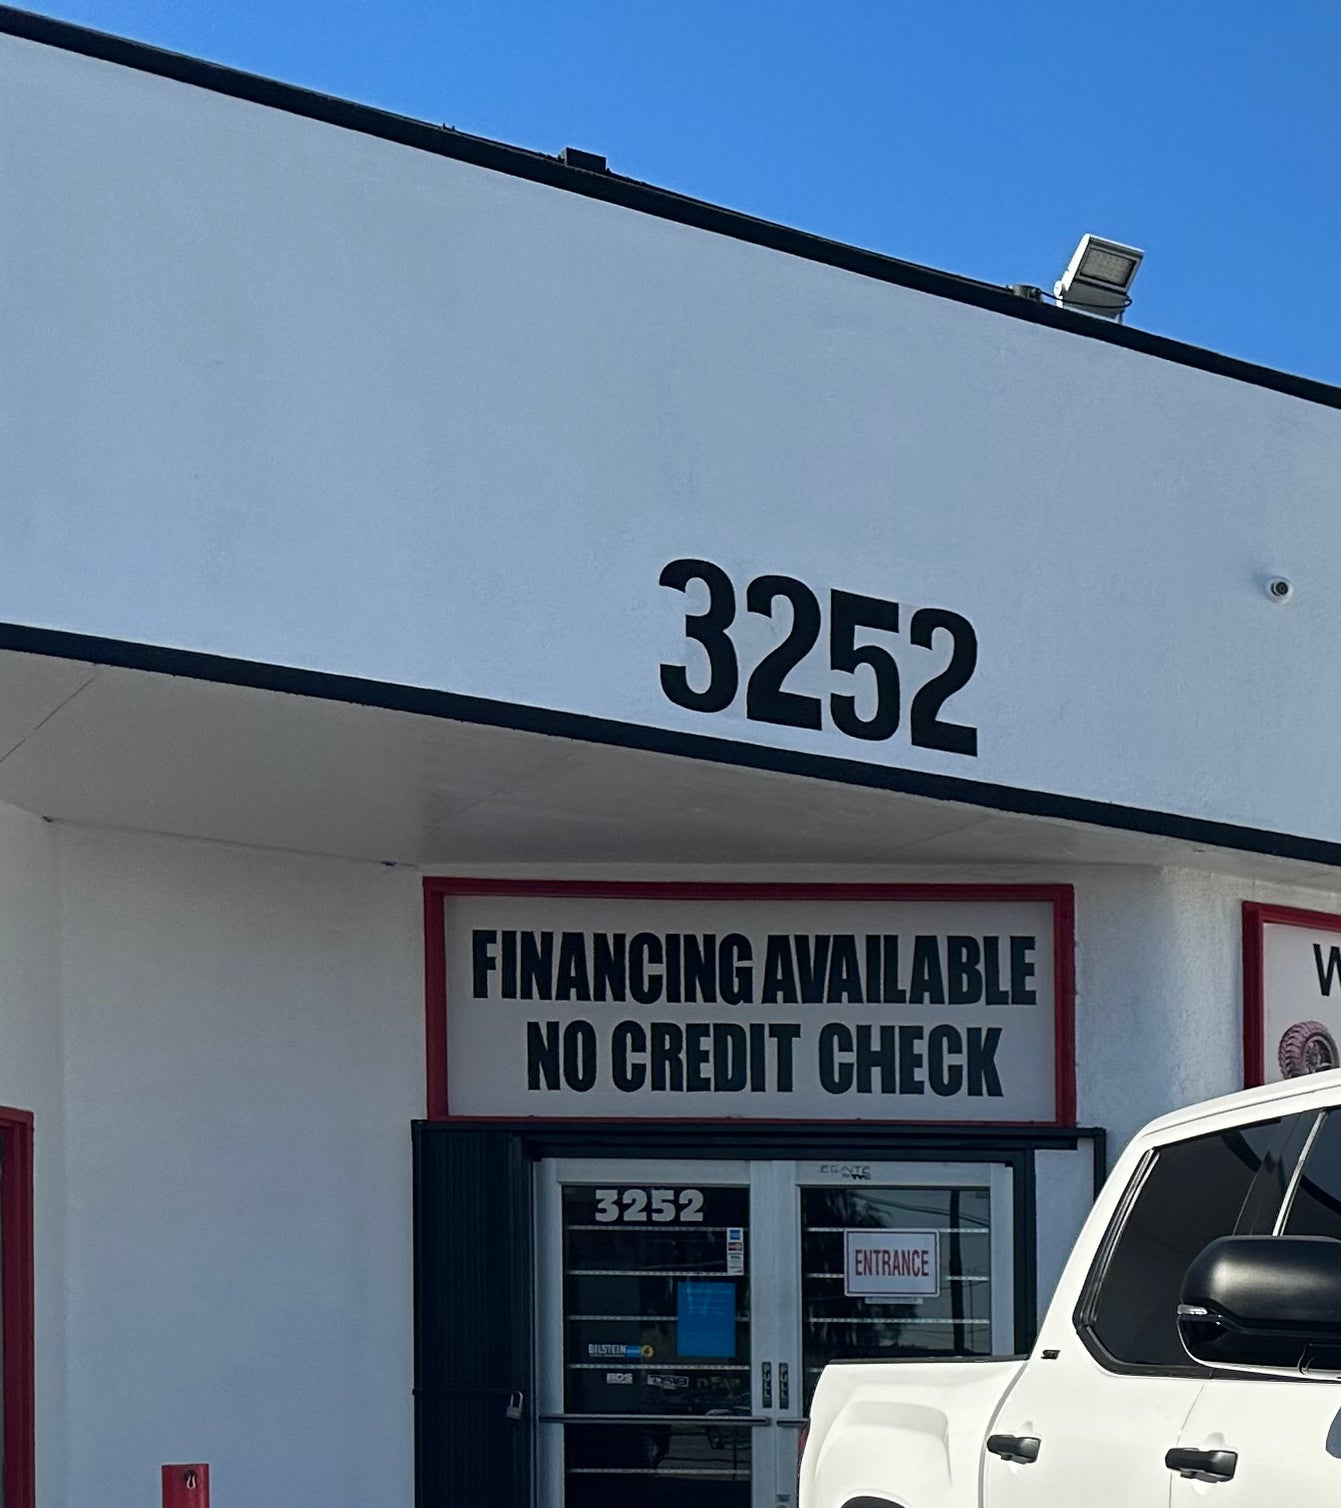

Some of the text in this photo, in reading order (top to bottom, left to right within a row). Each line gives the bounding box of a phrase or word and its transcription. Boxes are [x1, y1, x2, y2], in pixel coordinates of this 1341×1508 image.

[659, 558, 978, 758] 3252
[472, 929, 1037, 1006] FINANCING AVAILABLE
[527, 1020, 1004, 1098] NO CREDIT CHECK
[595, 1189, 704, 1222] 3252
[855, 1249, 930, 1277] ENTRANCE
